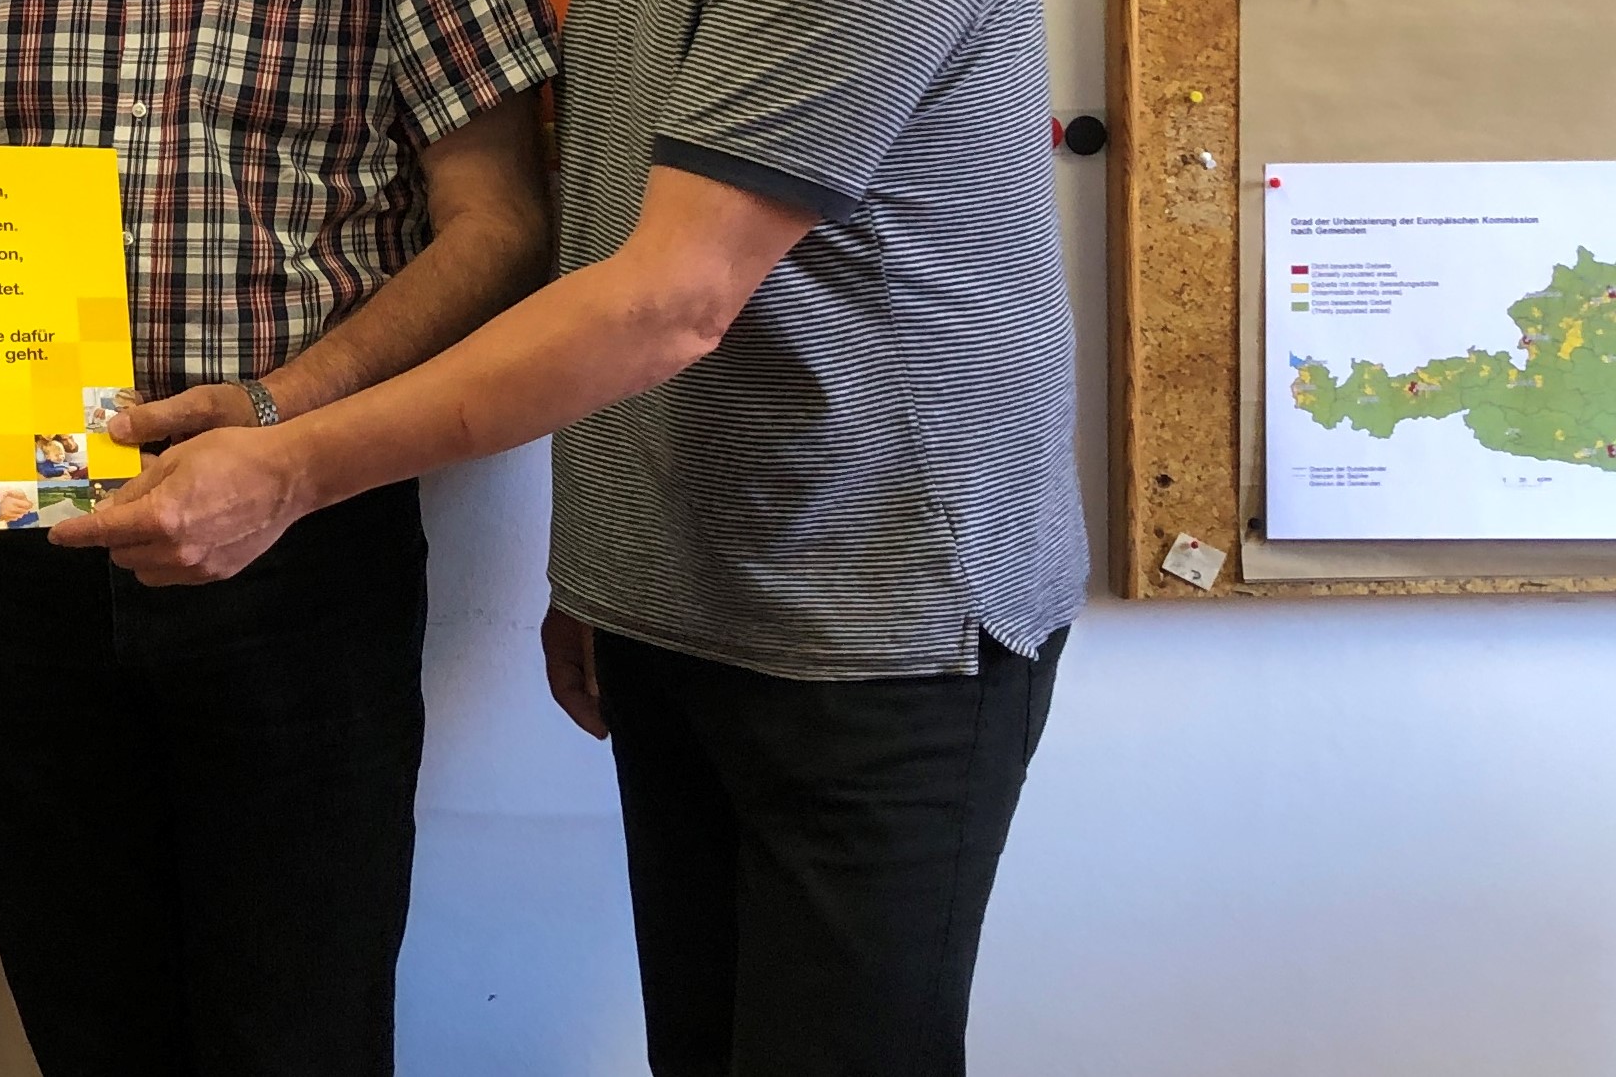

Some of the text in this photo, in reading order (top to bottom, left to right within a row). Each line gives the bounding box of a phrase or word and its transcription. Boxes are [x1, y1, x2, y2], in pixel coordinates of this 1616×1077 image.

[1290, 216, 1539, 227] Grad der Urbanisierung der Europäischen Kommission
[1290, 227, 1367, 235] nach Gemeinden
[10, 328, 55, 343] dafür
[5, 347, 49, 364] geht.
